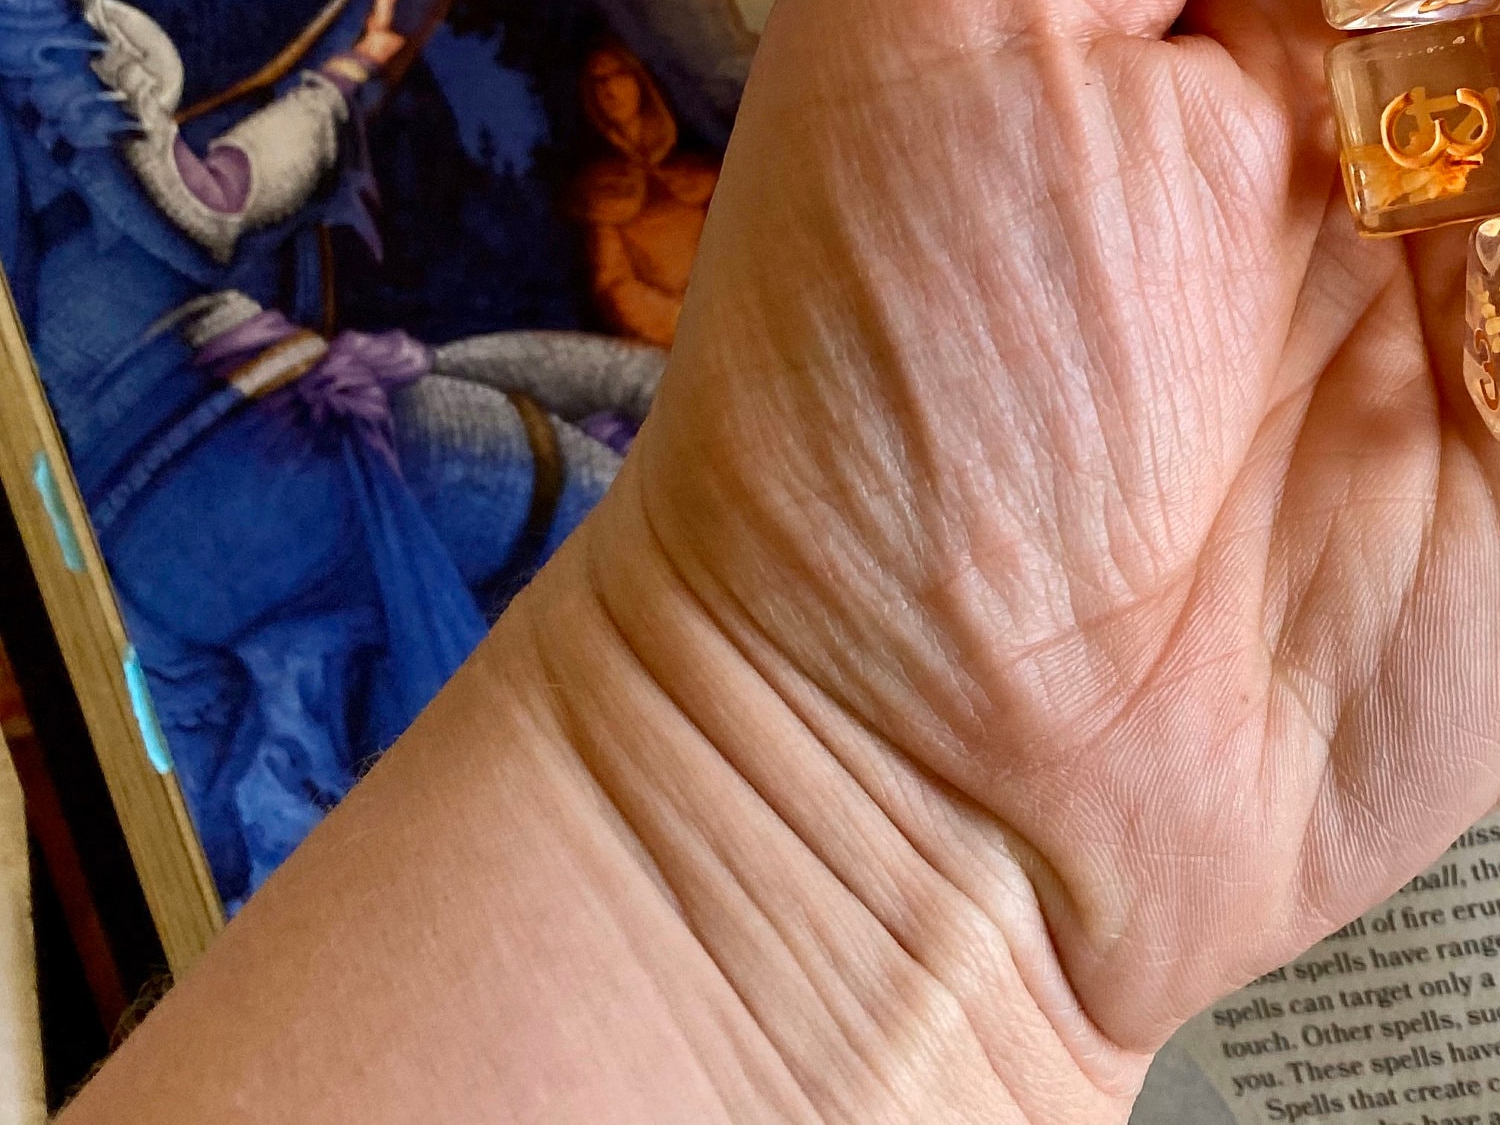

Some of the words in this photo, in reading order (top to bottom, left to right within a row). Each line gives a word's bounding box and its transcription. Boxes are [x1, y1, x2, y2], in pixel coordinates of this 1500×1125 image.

[1292, 951, 1367, 984] spells
[1368, 946, 1430, 969] have
[1301, 1022, 1374, 1048] Other
